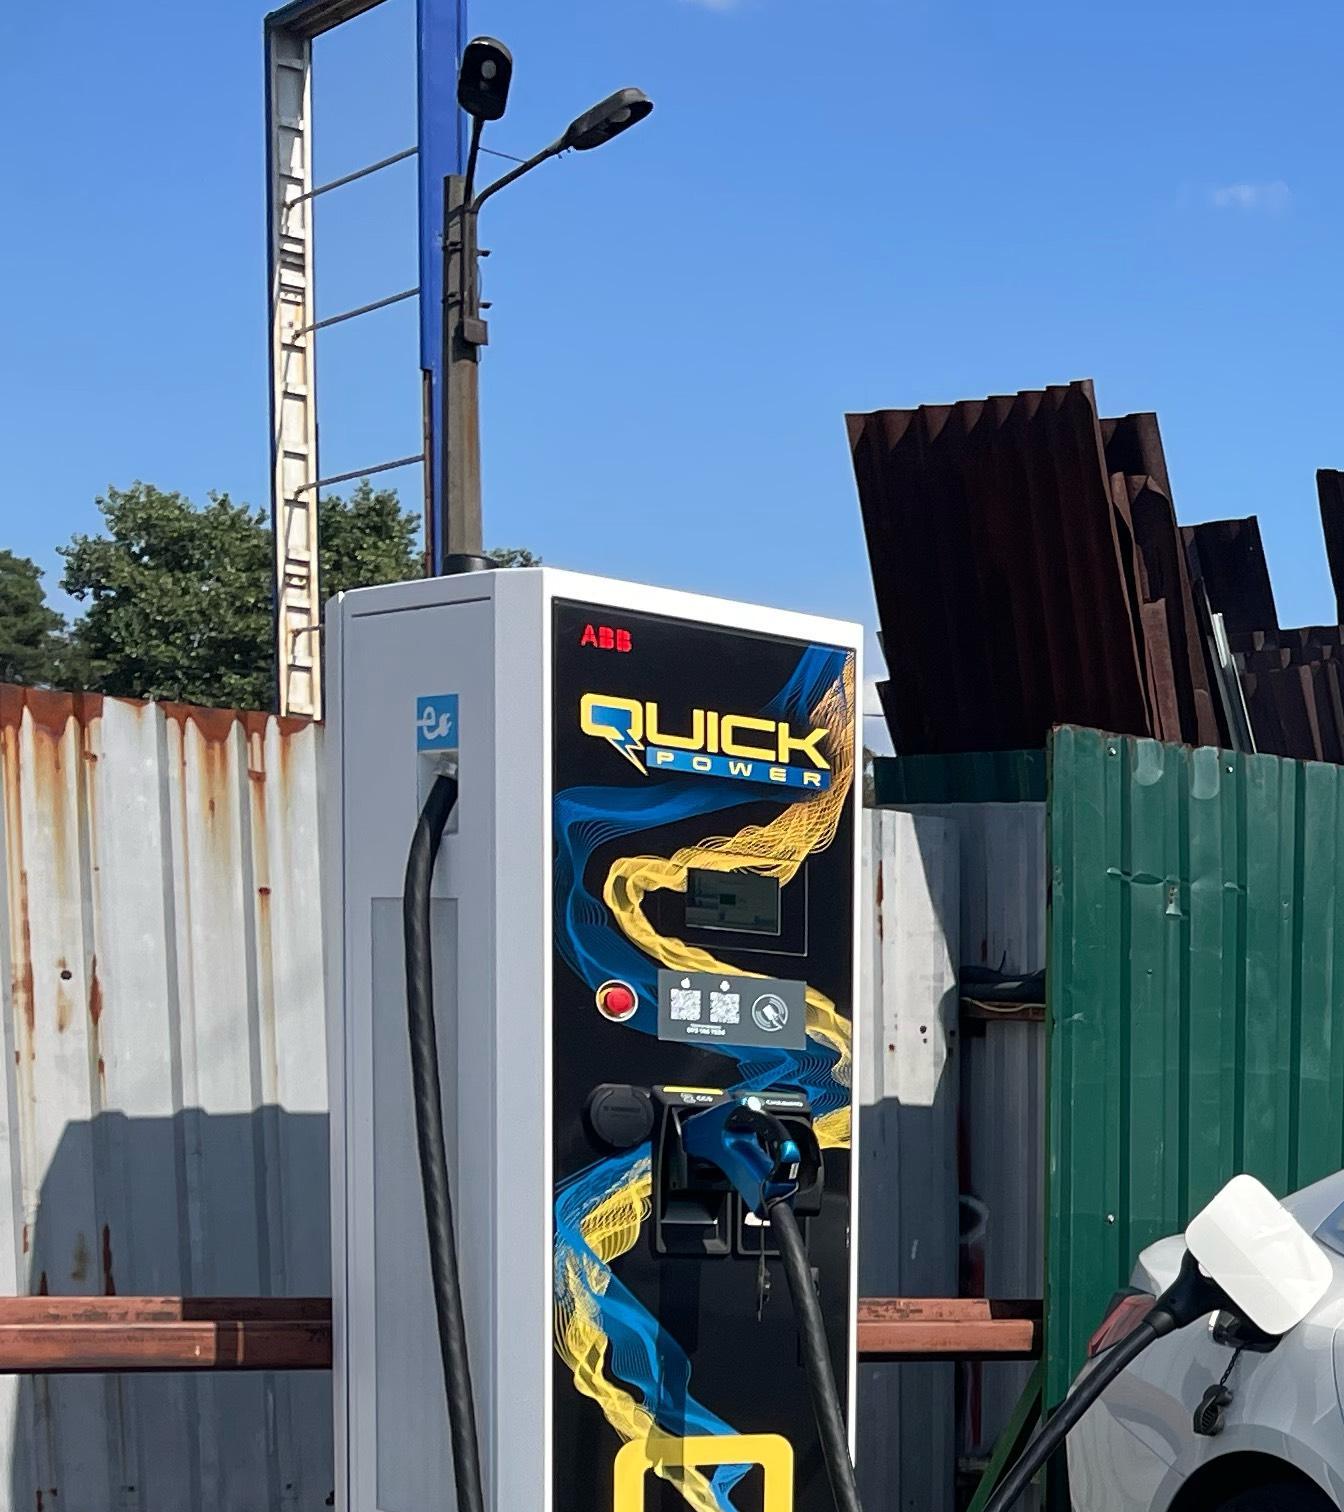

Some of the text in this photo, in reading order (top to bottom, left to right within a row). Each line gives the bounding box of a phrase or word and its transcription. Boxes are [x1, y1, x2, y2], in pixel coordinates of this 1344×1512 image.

[581, 624, 632, 652] ABB
[580, 693, 831, 776] QUICK
[656, 751, 821, 787] POWER
